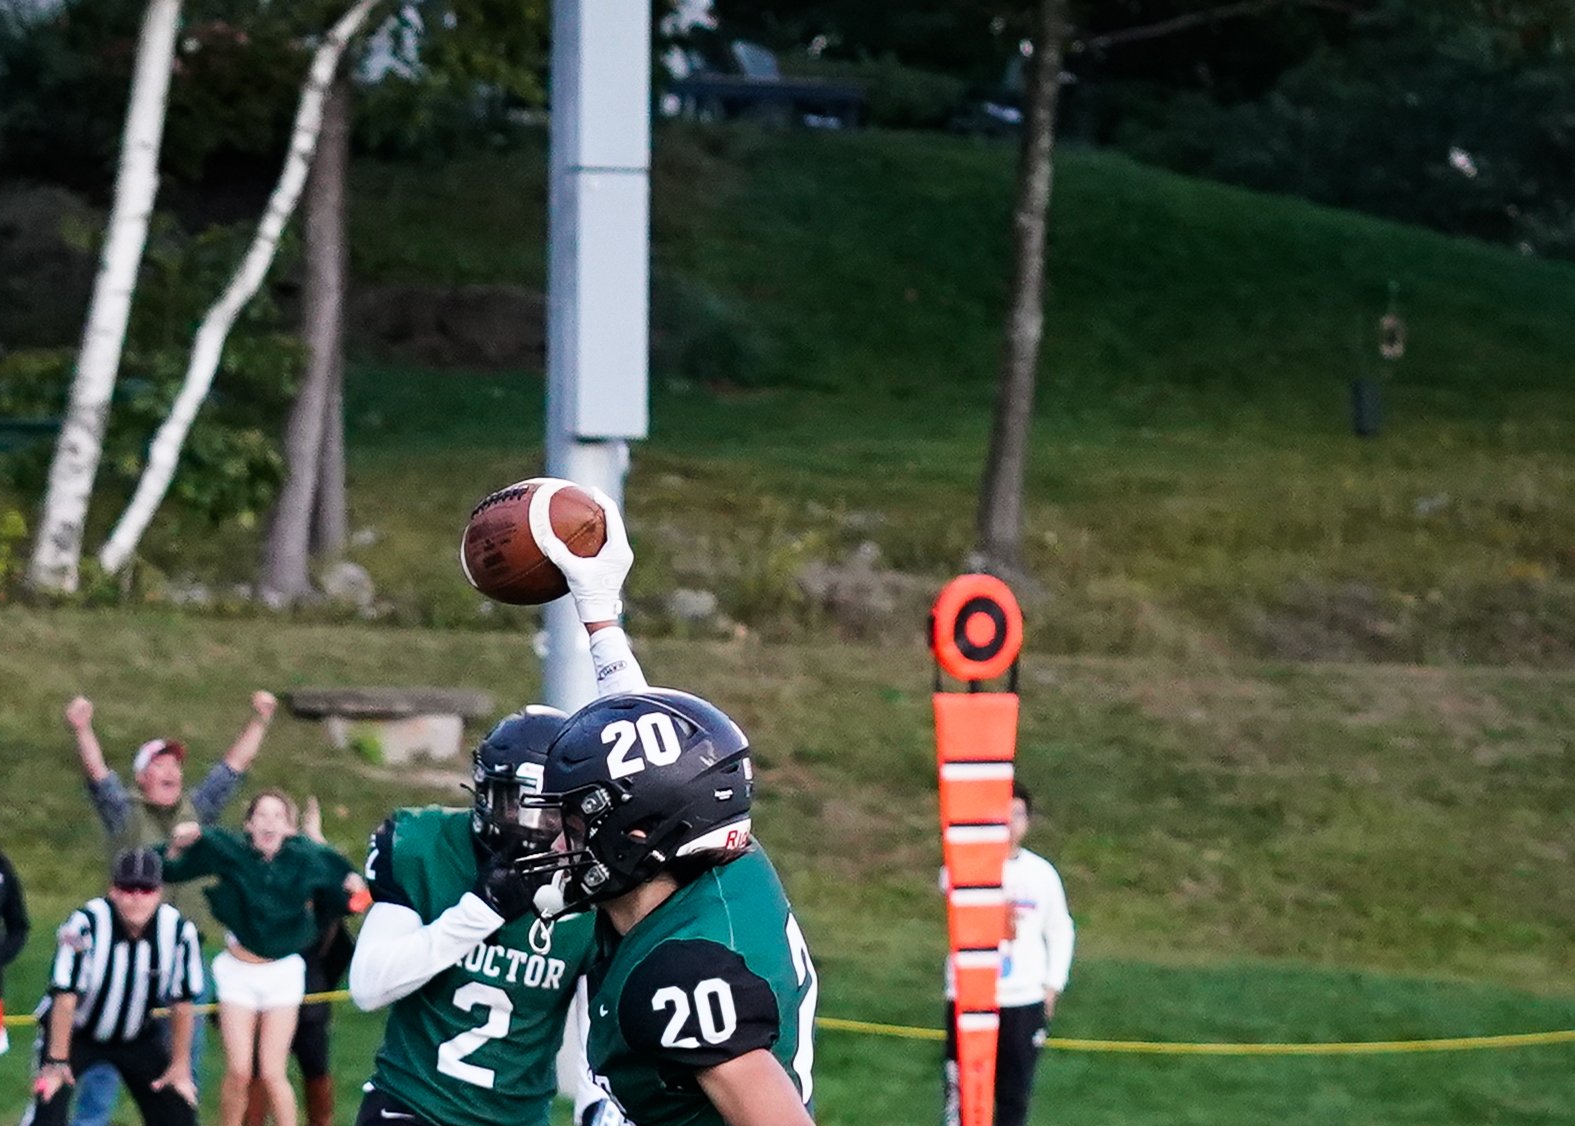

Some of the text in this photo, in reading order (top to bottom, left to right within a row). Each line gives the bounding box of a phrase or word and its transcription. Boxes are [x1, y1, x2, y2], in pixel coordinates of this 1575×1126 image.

[600, 711, 682, 781] 20
[455, 943, 566, 990] OCTOR
[437, 981, 514, 1089] 2
[651, 977, 738, 1050] 20
